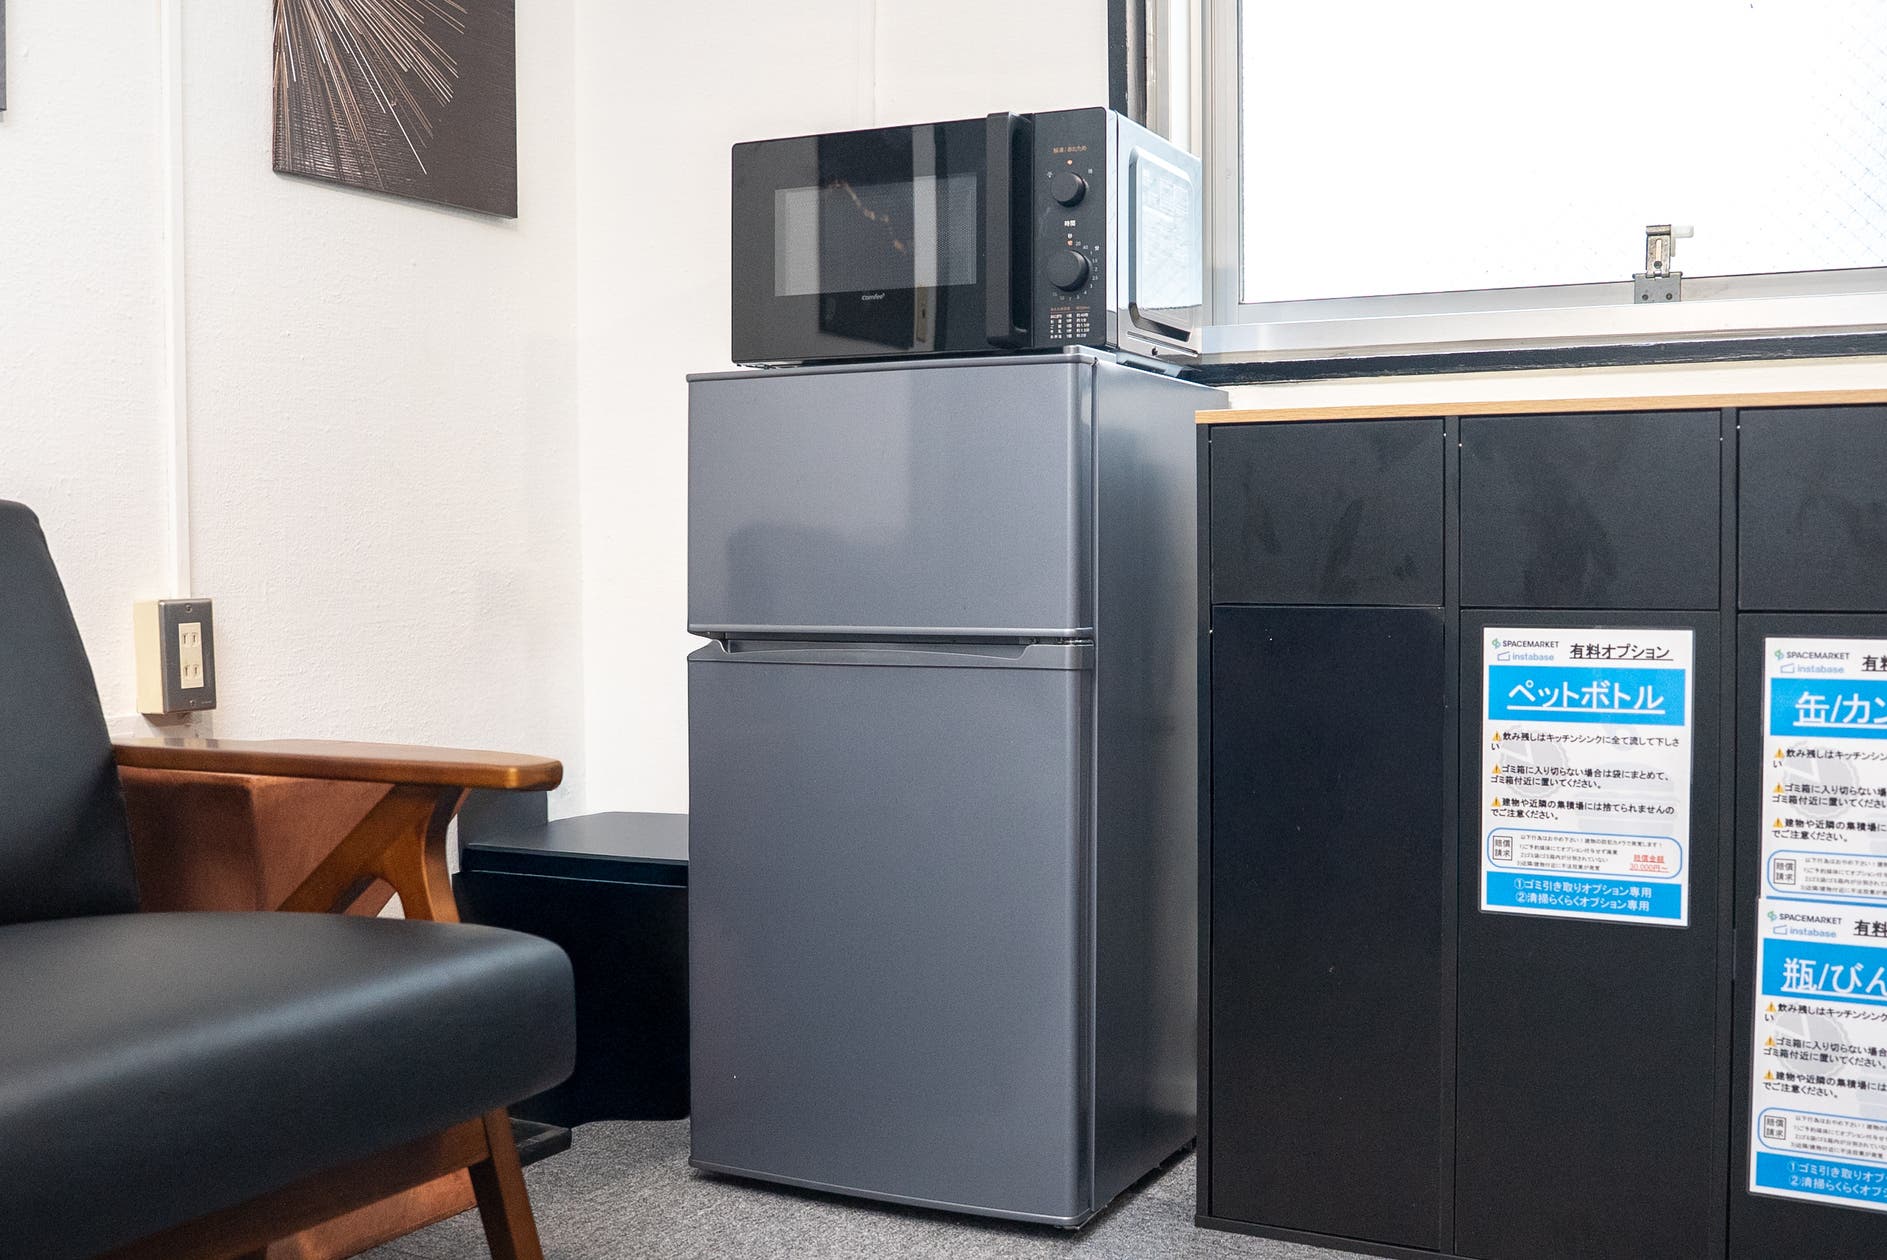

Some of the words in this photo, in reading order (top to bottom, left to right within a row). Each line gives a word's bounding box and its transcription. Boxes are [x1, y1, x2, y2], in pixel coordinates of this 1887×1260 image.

[1502, 640, 1559, 648] SPACEMARKET
[1512, 652, 1554, 661] instabase
[1570, 643, 1671, 659] 有料オプション
[1786, 651, 1850, 660] SPACEMARKET
[1797, 664, 1844, 673] instabase
[1508, 680, 1664, 709] ペットボトル
[1794, 691, 1887, 723] 缶/カン
[1491, 743, 1500, 751] い
[1773, 760, 1782, 768] い
[1490, 776, 1602, 789] ゴミ箱付近に置いてください。
[1491, 809, 1559, 820] でご注意ください。
[1772, 830, 1847, 842] でご注意ください。
[1779, 913, 1842, 925] SPACEMARKET
[1790, 927, 1836, 937] instabase
[1854, 920, 1887, 937] 有料
[1782, 958, 1887, 996] 瓶/びん
[1765, 1014, 1774, 1022] い
[1763, 1047, 1886, 1069] ゴミ箱付近に置いてください。
[1763, 1082, 1838, 1098] でご注意ください。
[1787, 1161, 1887, 1183] ①ゴミ引き取りオプ
